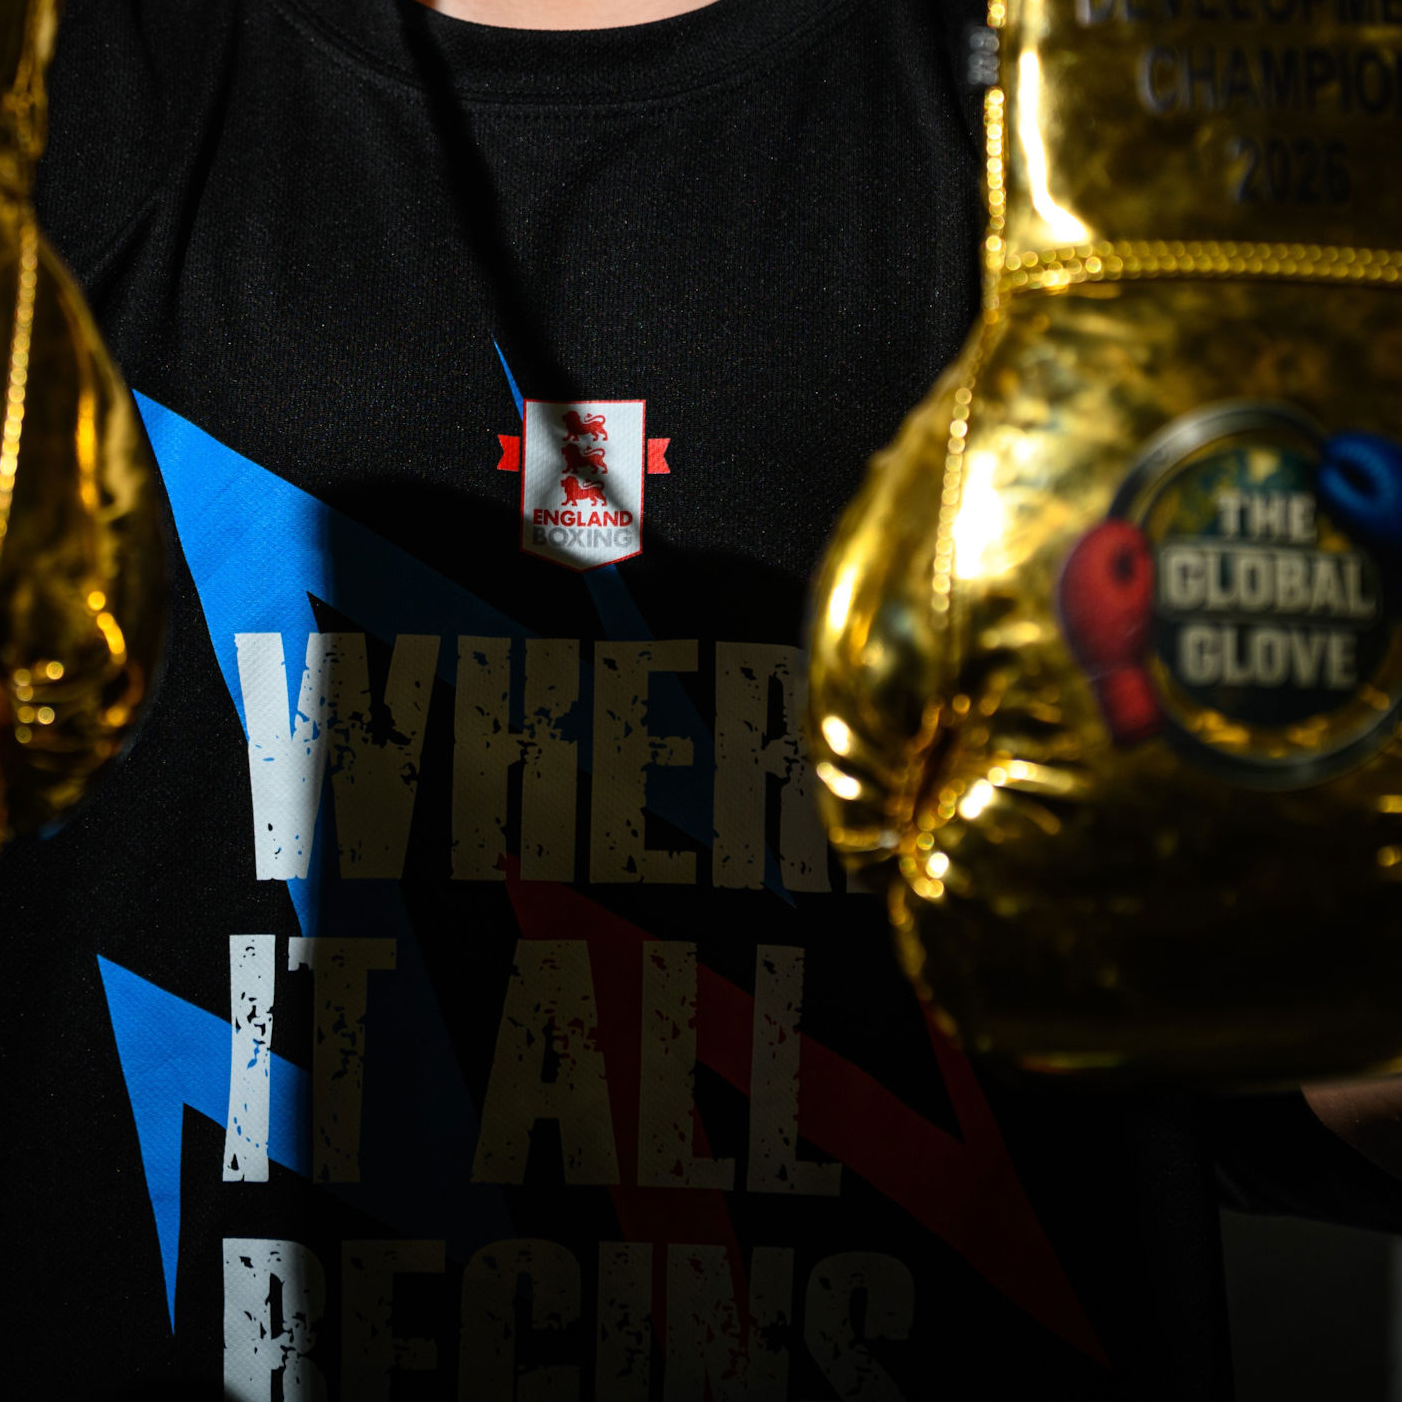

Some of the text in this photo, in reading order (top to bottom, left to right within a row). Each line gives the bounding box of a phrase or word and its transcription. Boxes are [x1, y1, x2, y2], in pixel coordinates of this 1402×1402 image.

[1228, 136, 1352, 205] 2026
[532, 509, 633, 527] ENGLAND
[532, 527, 633, 548] BOXING
[1216, 490, 1318, 542] THE
[1163, 545, 1378, 619] GLOBAL
[1177, 622, 1359, 690] GLOVE
[234, 632, 881, 895] WHER
[222, 934, 844, 1198] IT ALL
[222, 1238, 918, 1402] BEGINS
